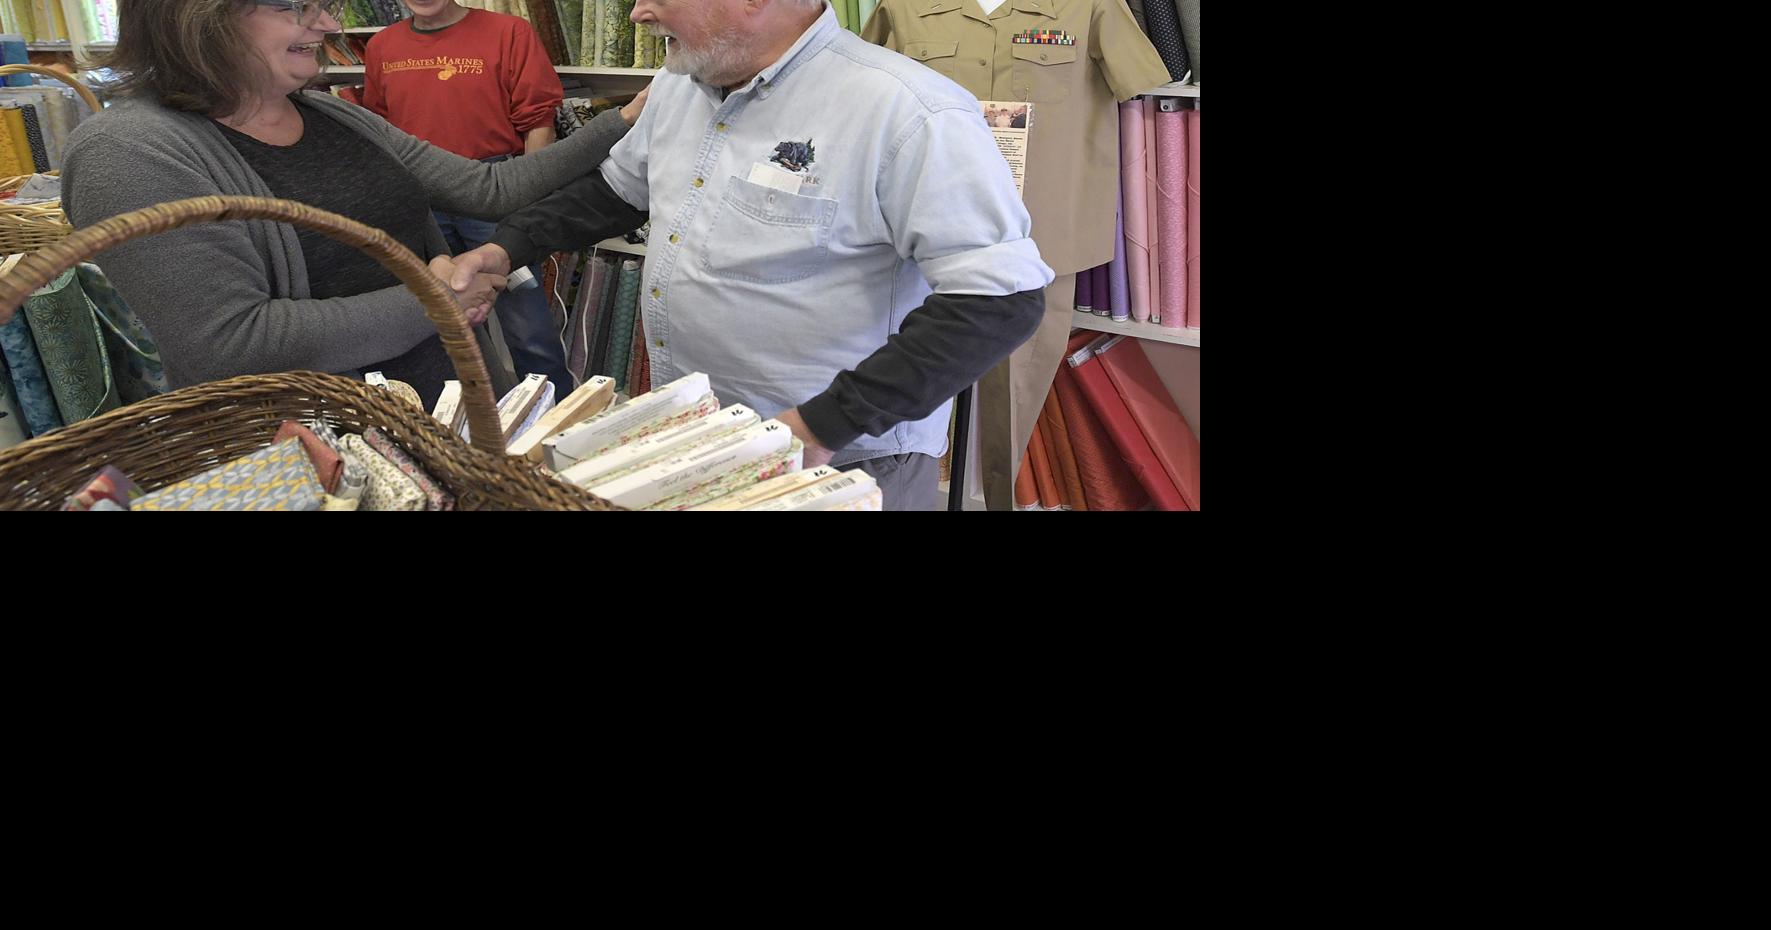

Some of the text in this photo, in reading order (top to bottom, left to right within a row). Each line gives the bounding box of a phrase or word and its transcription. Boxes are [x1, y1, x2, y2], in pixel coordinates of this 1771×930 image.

[382, 56, 484, 70] UNITED STATES MARINES
[458, 65, 483, 74] 1775
